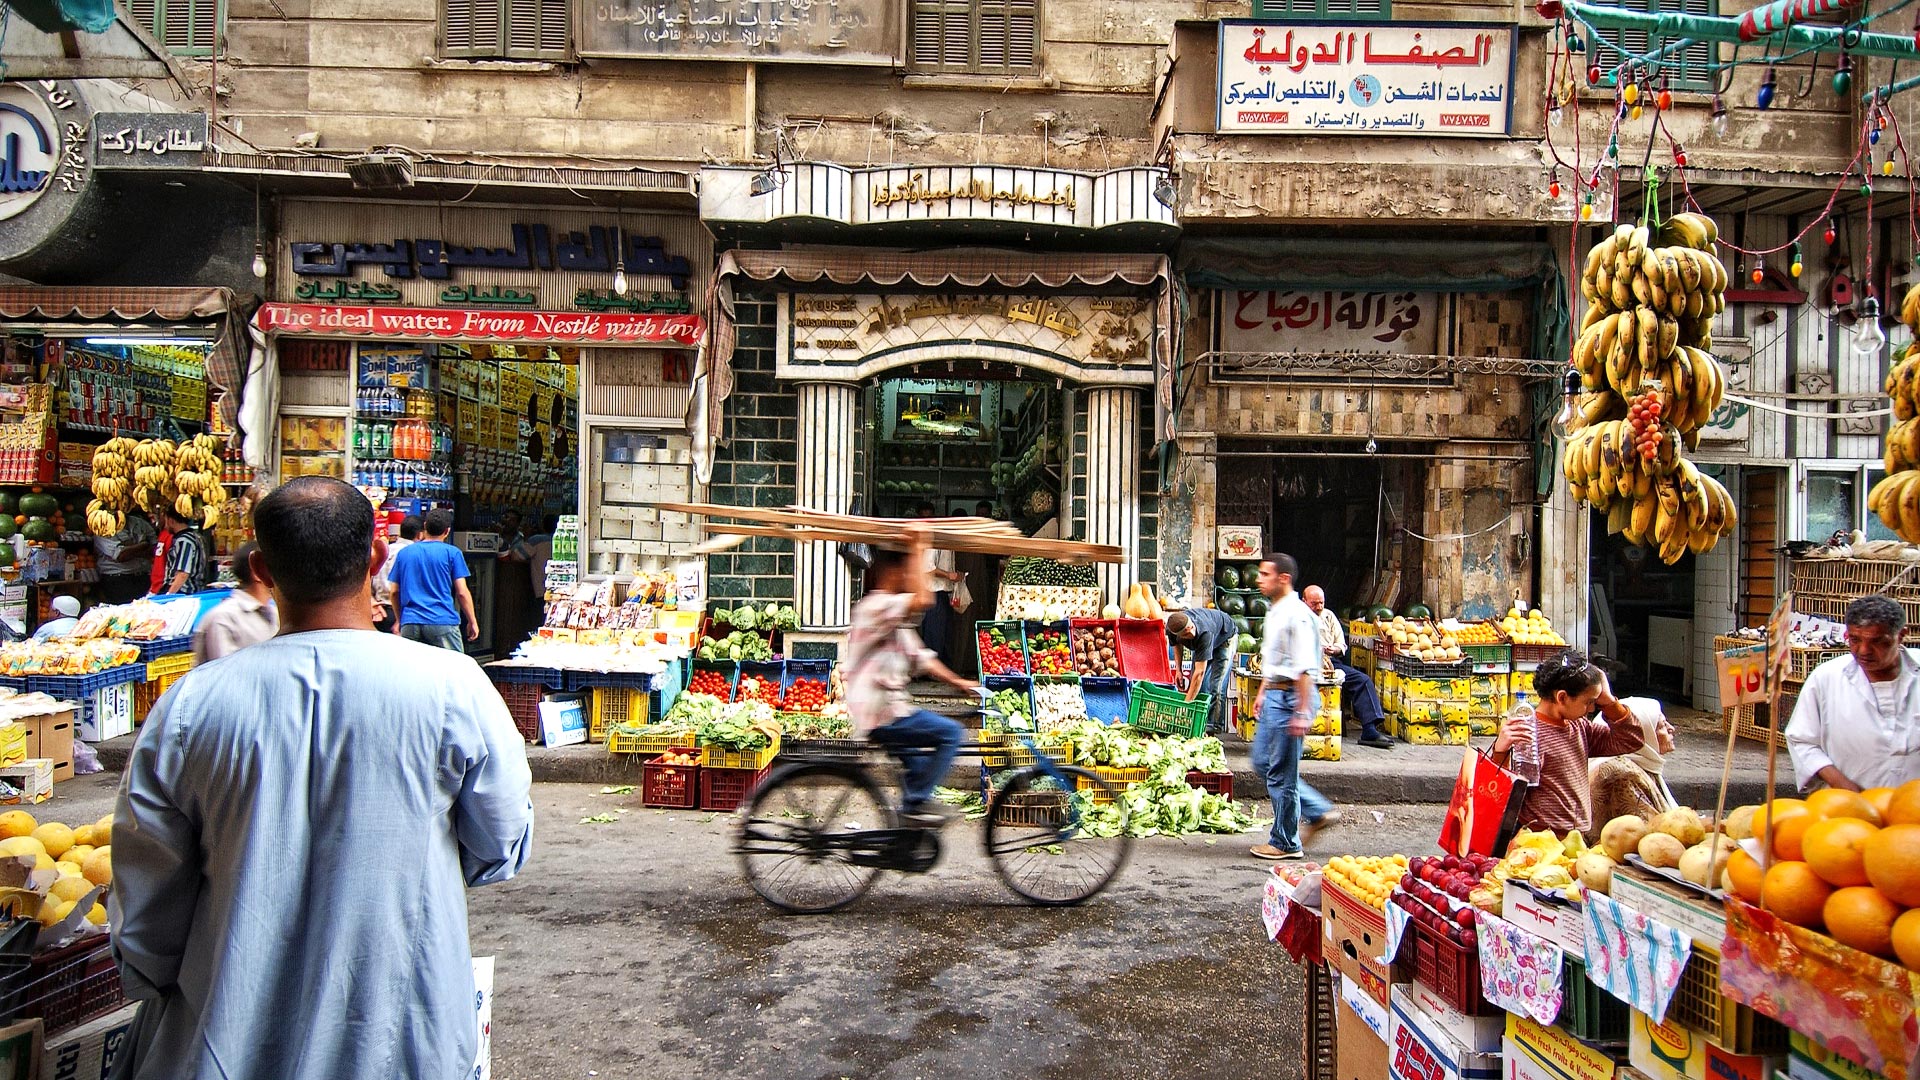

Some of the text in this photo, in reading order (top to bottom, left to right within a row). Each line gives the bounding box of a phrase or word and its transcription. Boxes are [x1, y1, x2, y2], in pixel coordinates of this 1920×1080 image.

[657, 4, 732, 28] الصناعية
[1243, 27, 1494, 75] الصفا الدولية
[1275, 79, 1345, 106] والتخليص
[1384, 80, 1442, 105] الشحن
[1446, 82, 1503, 103] لخدمات
[1371, 111, 1425, 130] والتصدير
[101, 127, 203, 155] سلطان ماركت
[290, 223, 550, 280] السويس
[267, 306, 313, 327] The
[319, 308, 375, 329] ideal
[380, 314, 453, 332] water.
[459, 311, 525, 334] From
[528, 314, 601, 340] Nestlé
[605, 317, 657, 337] with
[394, 361, 417, 373] OMO
[1515, 1019, 1538, 1043] Egyptian
[1537, 1035, 1552, 1054] Fresh
[1552, 1045, 1569, 1066] Fruits
